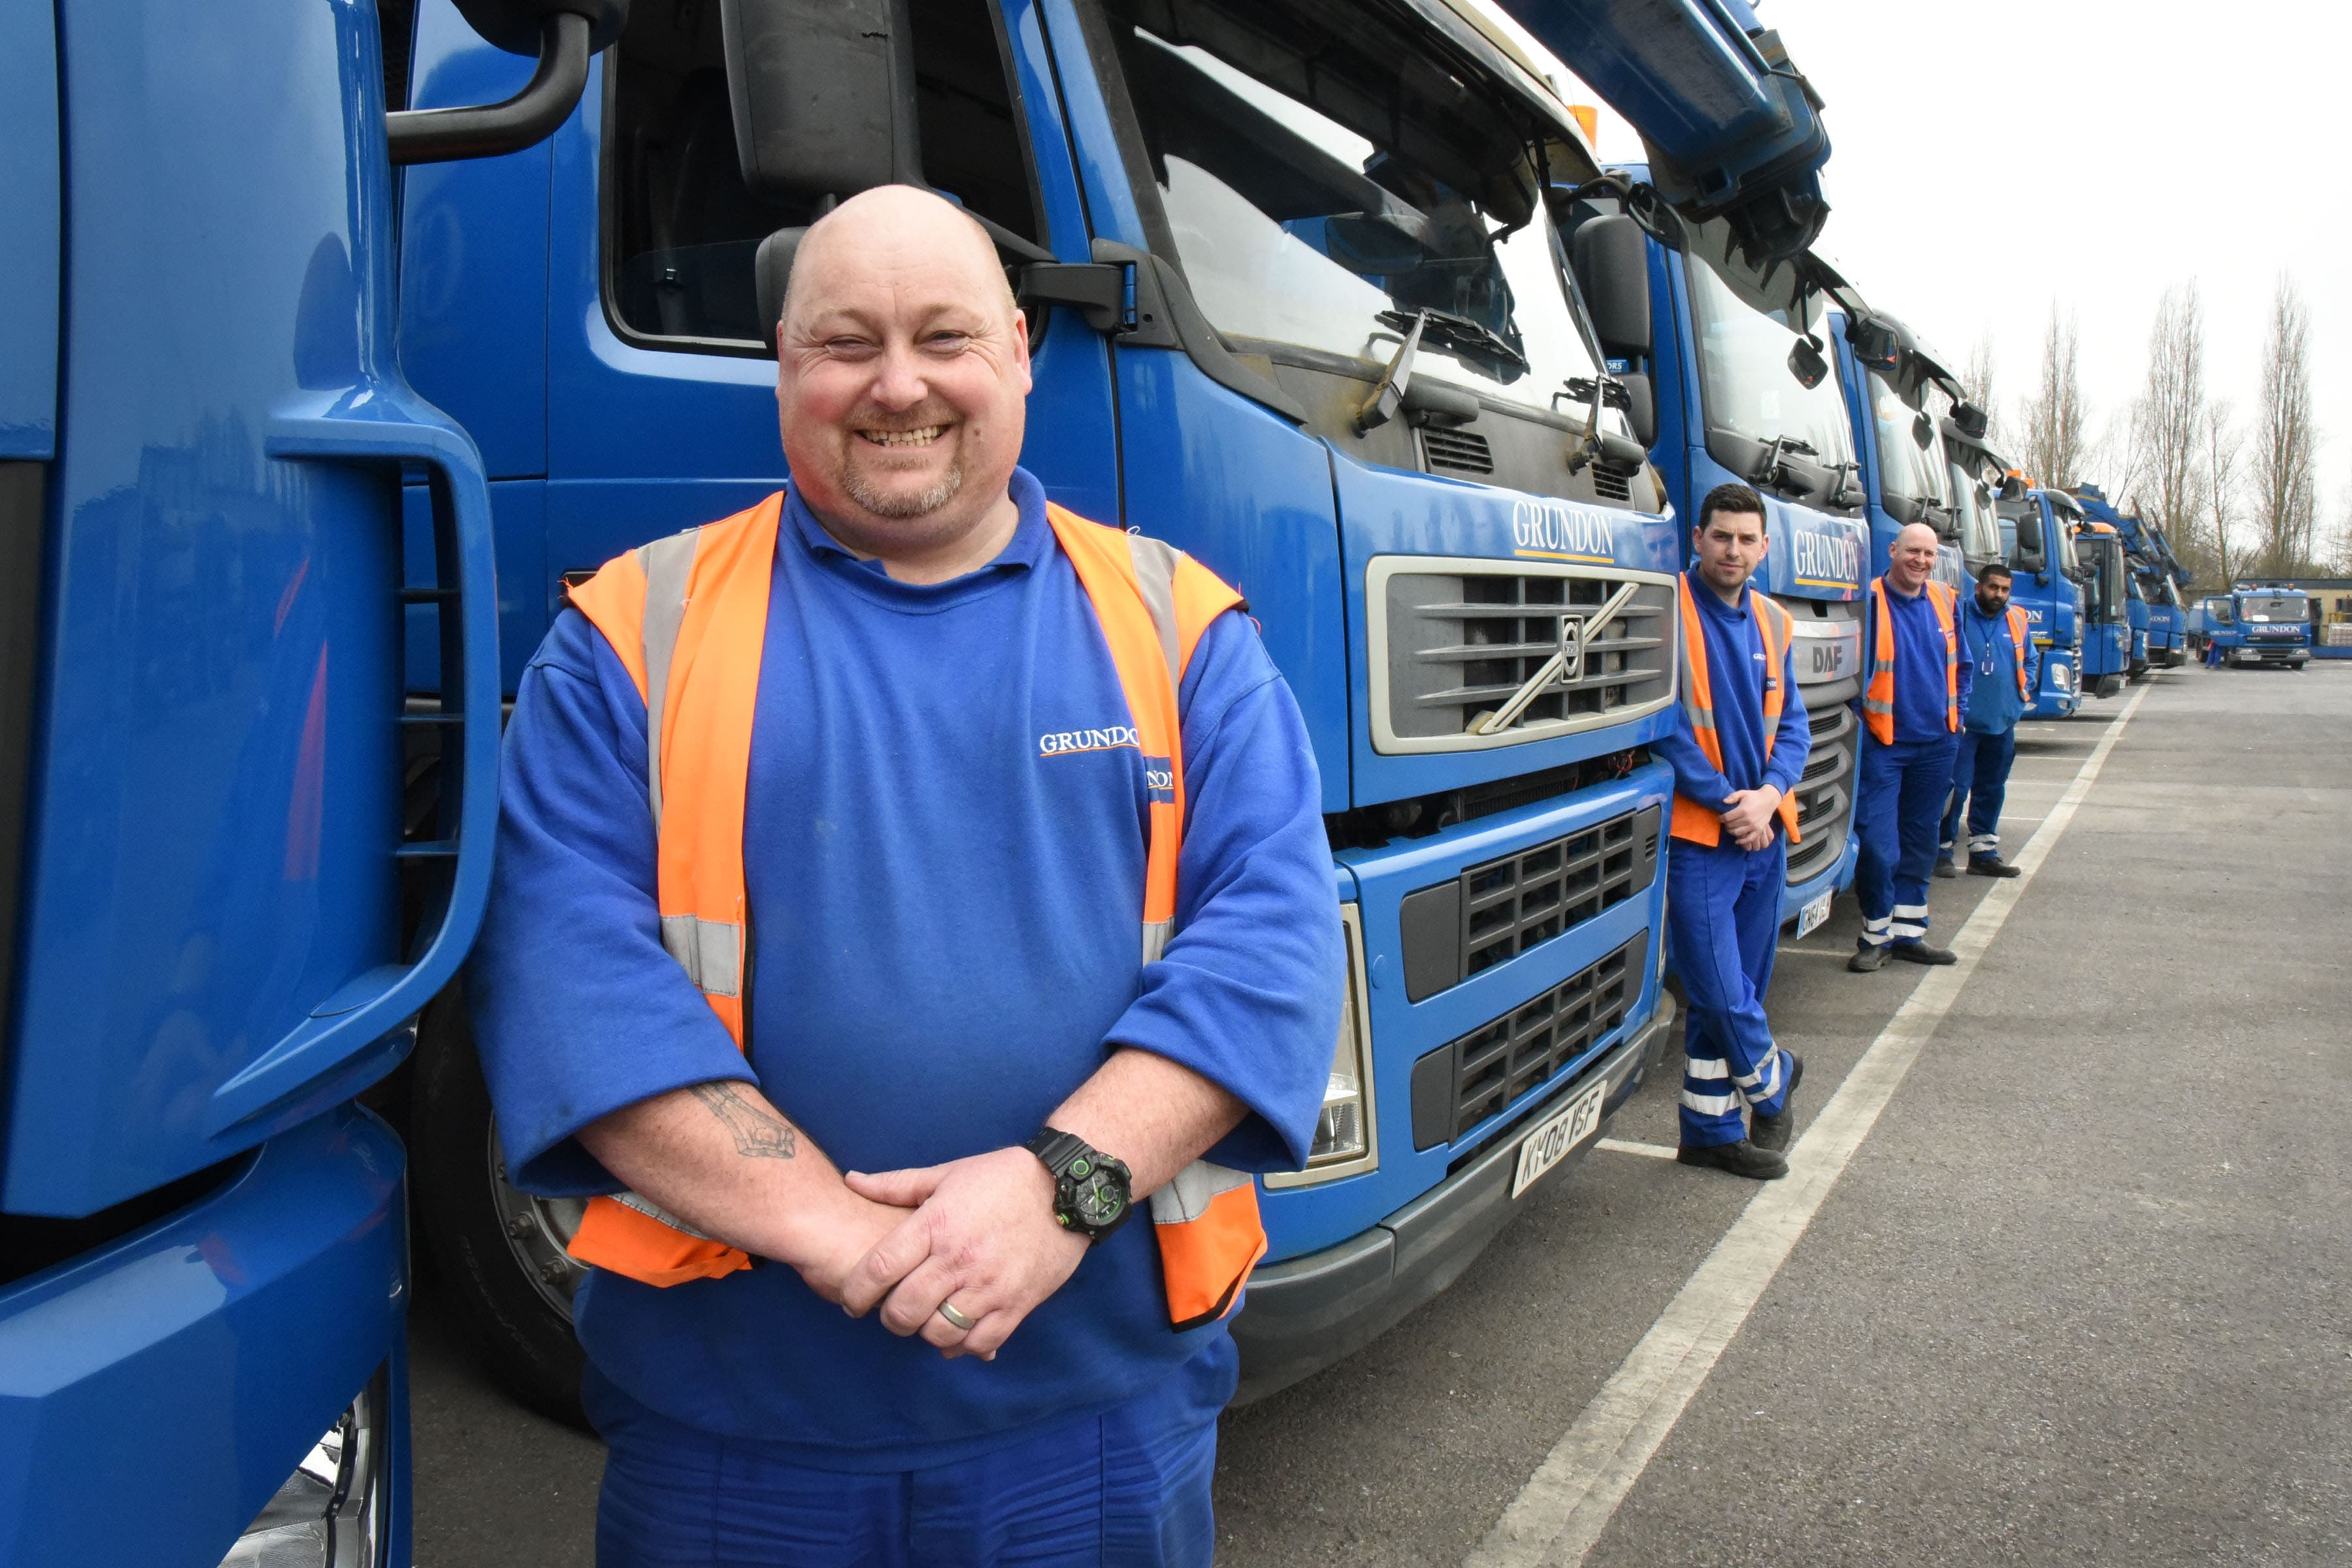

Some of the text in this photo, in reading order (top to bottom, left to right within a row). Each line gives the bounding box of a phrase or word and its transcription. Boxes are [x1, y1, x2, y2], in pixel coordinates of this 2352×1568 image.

[1513, 500, 1613, 555] GRUNDON
[1793, 529, 1858, 581] GRUNDON
[2252, 625, 2300, 634] GRUNDON
[1813, 645, 1842, 673] DAF
[1522, 1090, 1599, 1185] KY08 VSF
